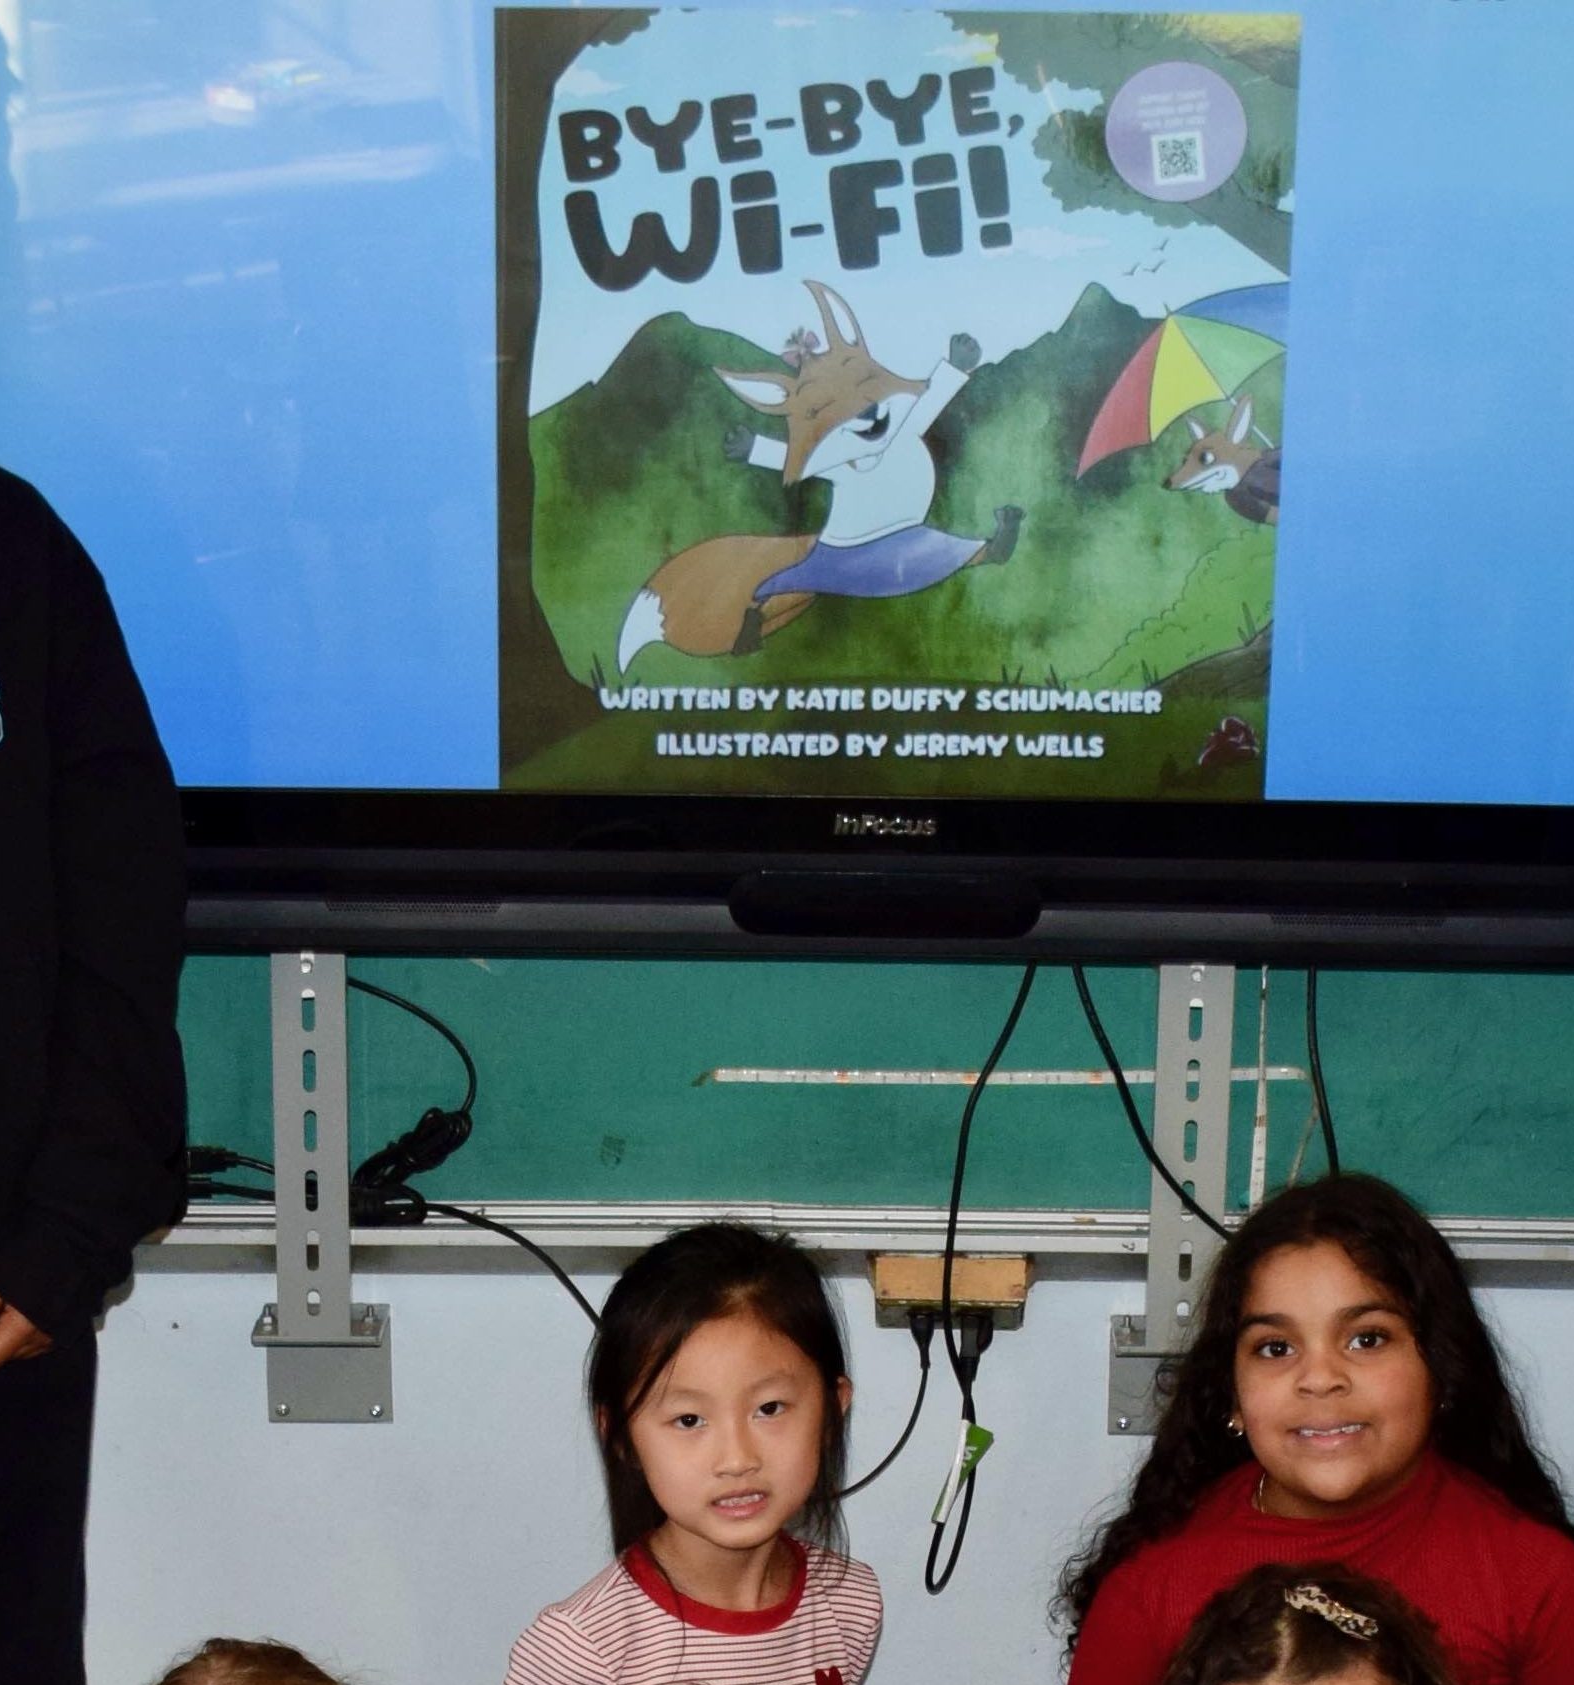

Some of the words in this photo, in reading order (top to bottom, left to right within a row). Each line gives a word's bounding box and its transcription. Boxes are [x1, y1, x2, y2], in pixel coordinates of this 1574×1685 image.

[558, 66, 1025, 183] BYE-BYE,
[599, 687, 731, 711] WRITTEN
[737, 687, 780, 711] BY
[785, 687, 866, 712] KATIE
[871, 687, 967, 712] DUFFY
[975, 688, 1163, 714] SCHUMACHER
[656, 732, 840, 757] ILLUSTRATED
[845, 733, 888, 757] BY
[894, 733, 1009, 758] JEREMY
[1014, 734, 1105, 758] WELLS
[833, 813, 937, 836] InFocus
